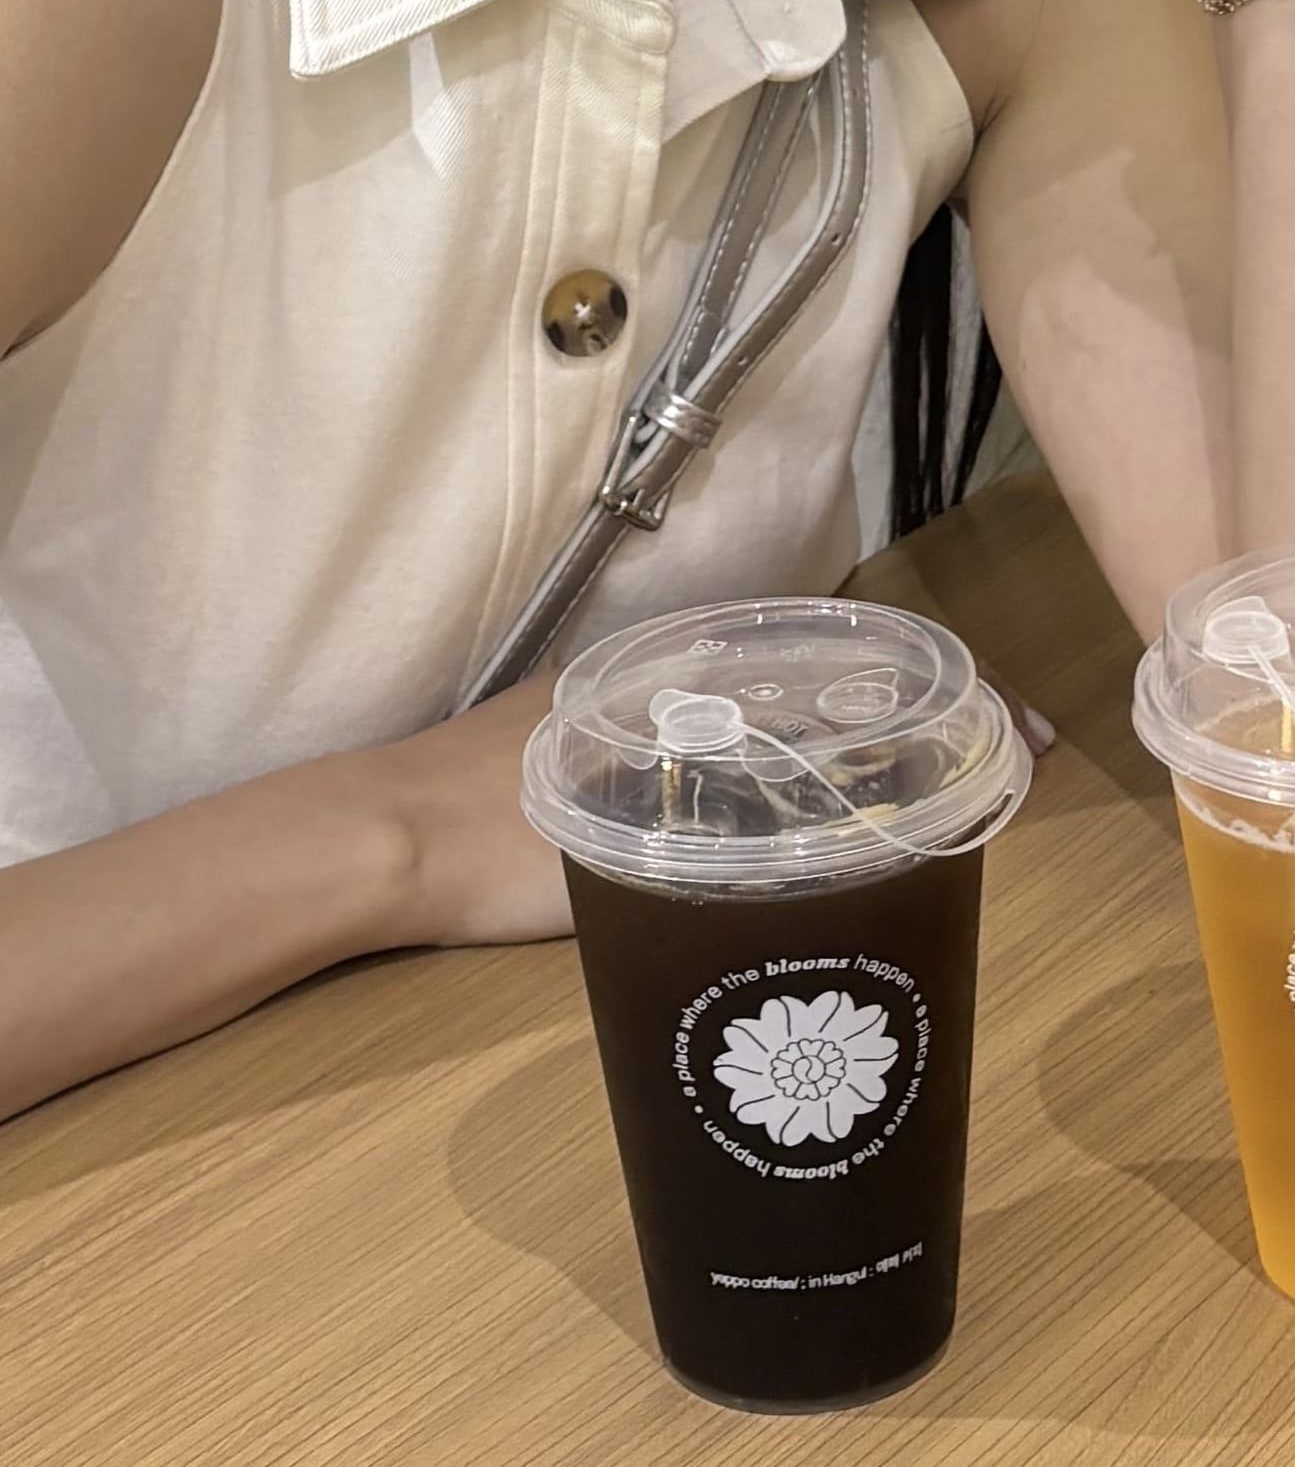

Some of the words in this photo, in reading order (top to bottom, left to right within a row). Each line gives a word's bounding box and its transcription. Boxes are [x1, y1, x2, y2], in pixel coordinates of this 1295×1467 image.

[721, 968, 760, 991] the
[765, 957, 850, 977] blooms
[854, 953, 915, 992] happen
[679, 984, 723, 1030] where
[672, 1030, 696, 1081] place
[914, 1018, 932, 1072] place
[883, 1076, 922, 1136] where
[703, 1120, 771, 1177] happen
[852, 1137, 885, 1165] the
[773, 1158, 849, 1179] blooms
[808, 1275, 821, 1288] in
[823, 1266, 867, 1285] Hangul
